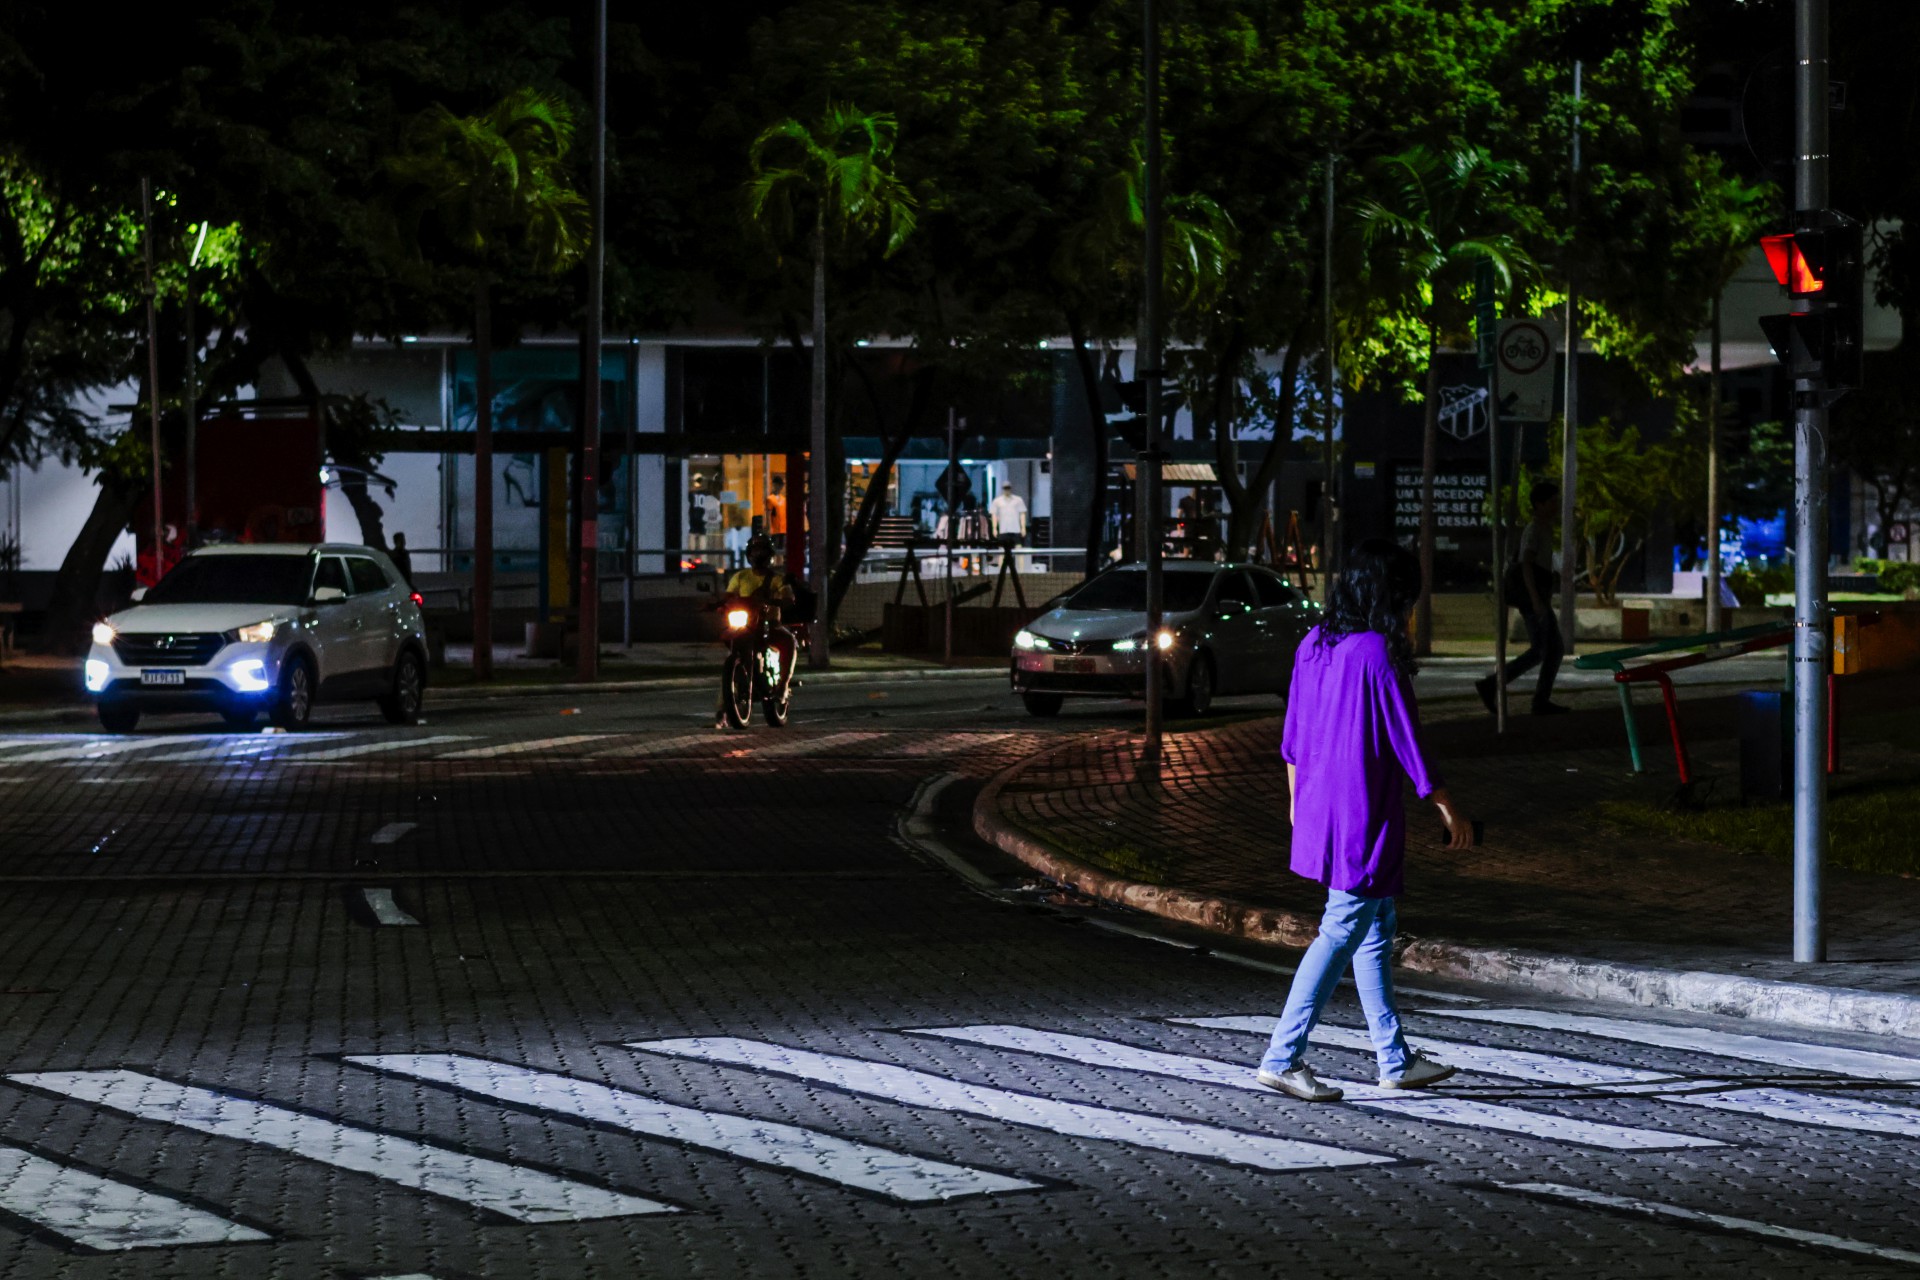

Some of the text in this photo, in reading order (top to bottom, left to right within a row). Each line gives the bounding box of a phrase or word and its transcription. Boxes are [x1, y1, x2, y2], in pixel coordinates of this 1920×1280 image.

[1395, 475, 1423, 486] SEJA
[1461, 475, 1487, 486] QUE
[1395, 488, 1484, 499] UM TRCEDOR
[694, 493, 706, 508] 10
[1471, 502, 1479, 512] E
[1438, 515, 1478, 526] DESSA
